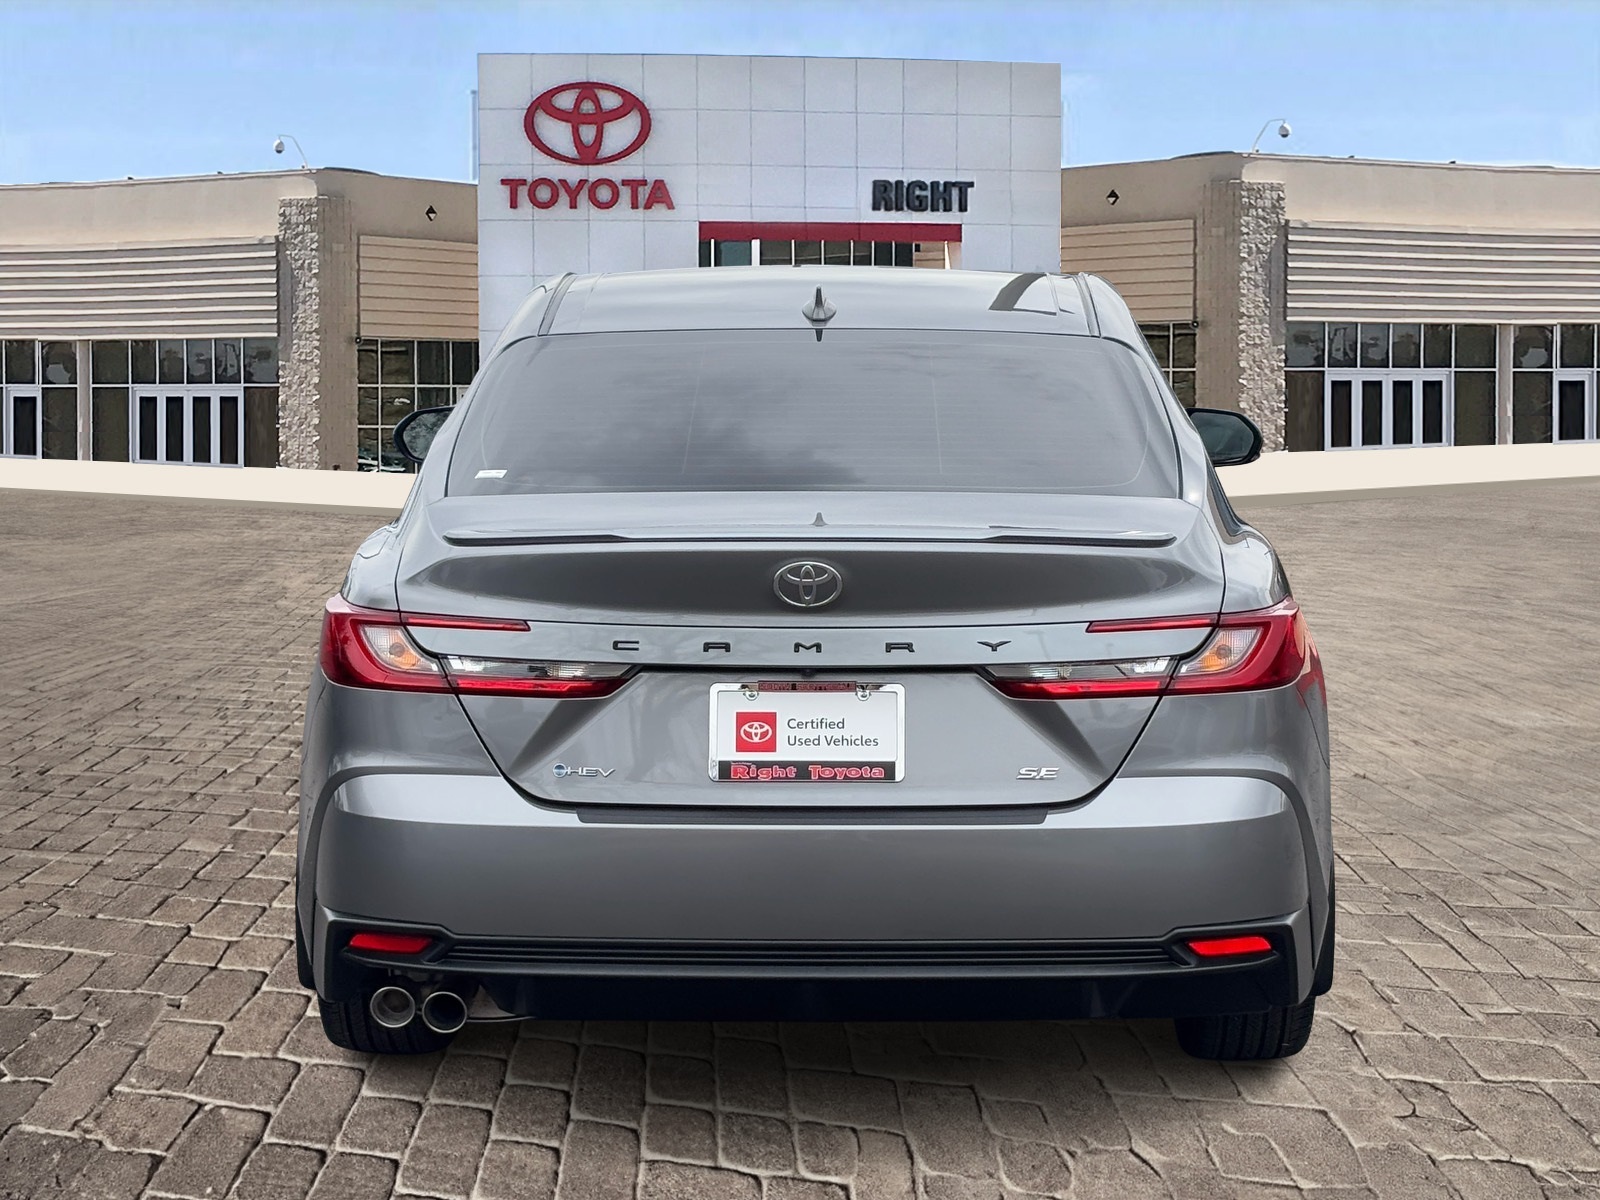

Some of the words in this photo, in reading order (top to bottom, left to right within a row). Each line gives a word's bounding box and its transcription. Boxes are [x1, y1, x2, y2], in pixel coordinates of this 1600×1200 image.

[500, 178, 675, 210] TOYOTA
[872, 180, 974, 212] RIGHT
[612, 640, 1012, 653] CAMRY
[787, 717, 845, 730] Certified
[787, 734, 821, 747] Used
[824, 734, 879, 747] Vehicles
[566, 766, 616, 778] HEV
[731, 764, 797, 780] Right
[808, 764, 885, 780] Toyota
[1016, 767, 1060, 780] SE
